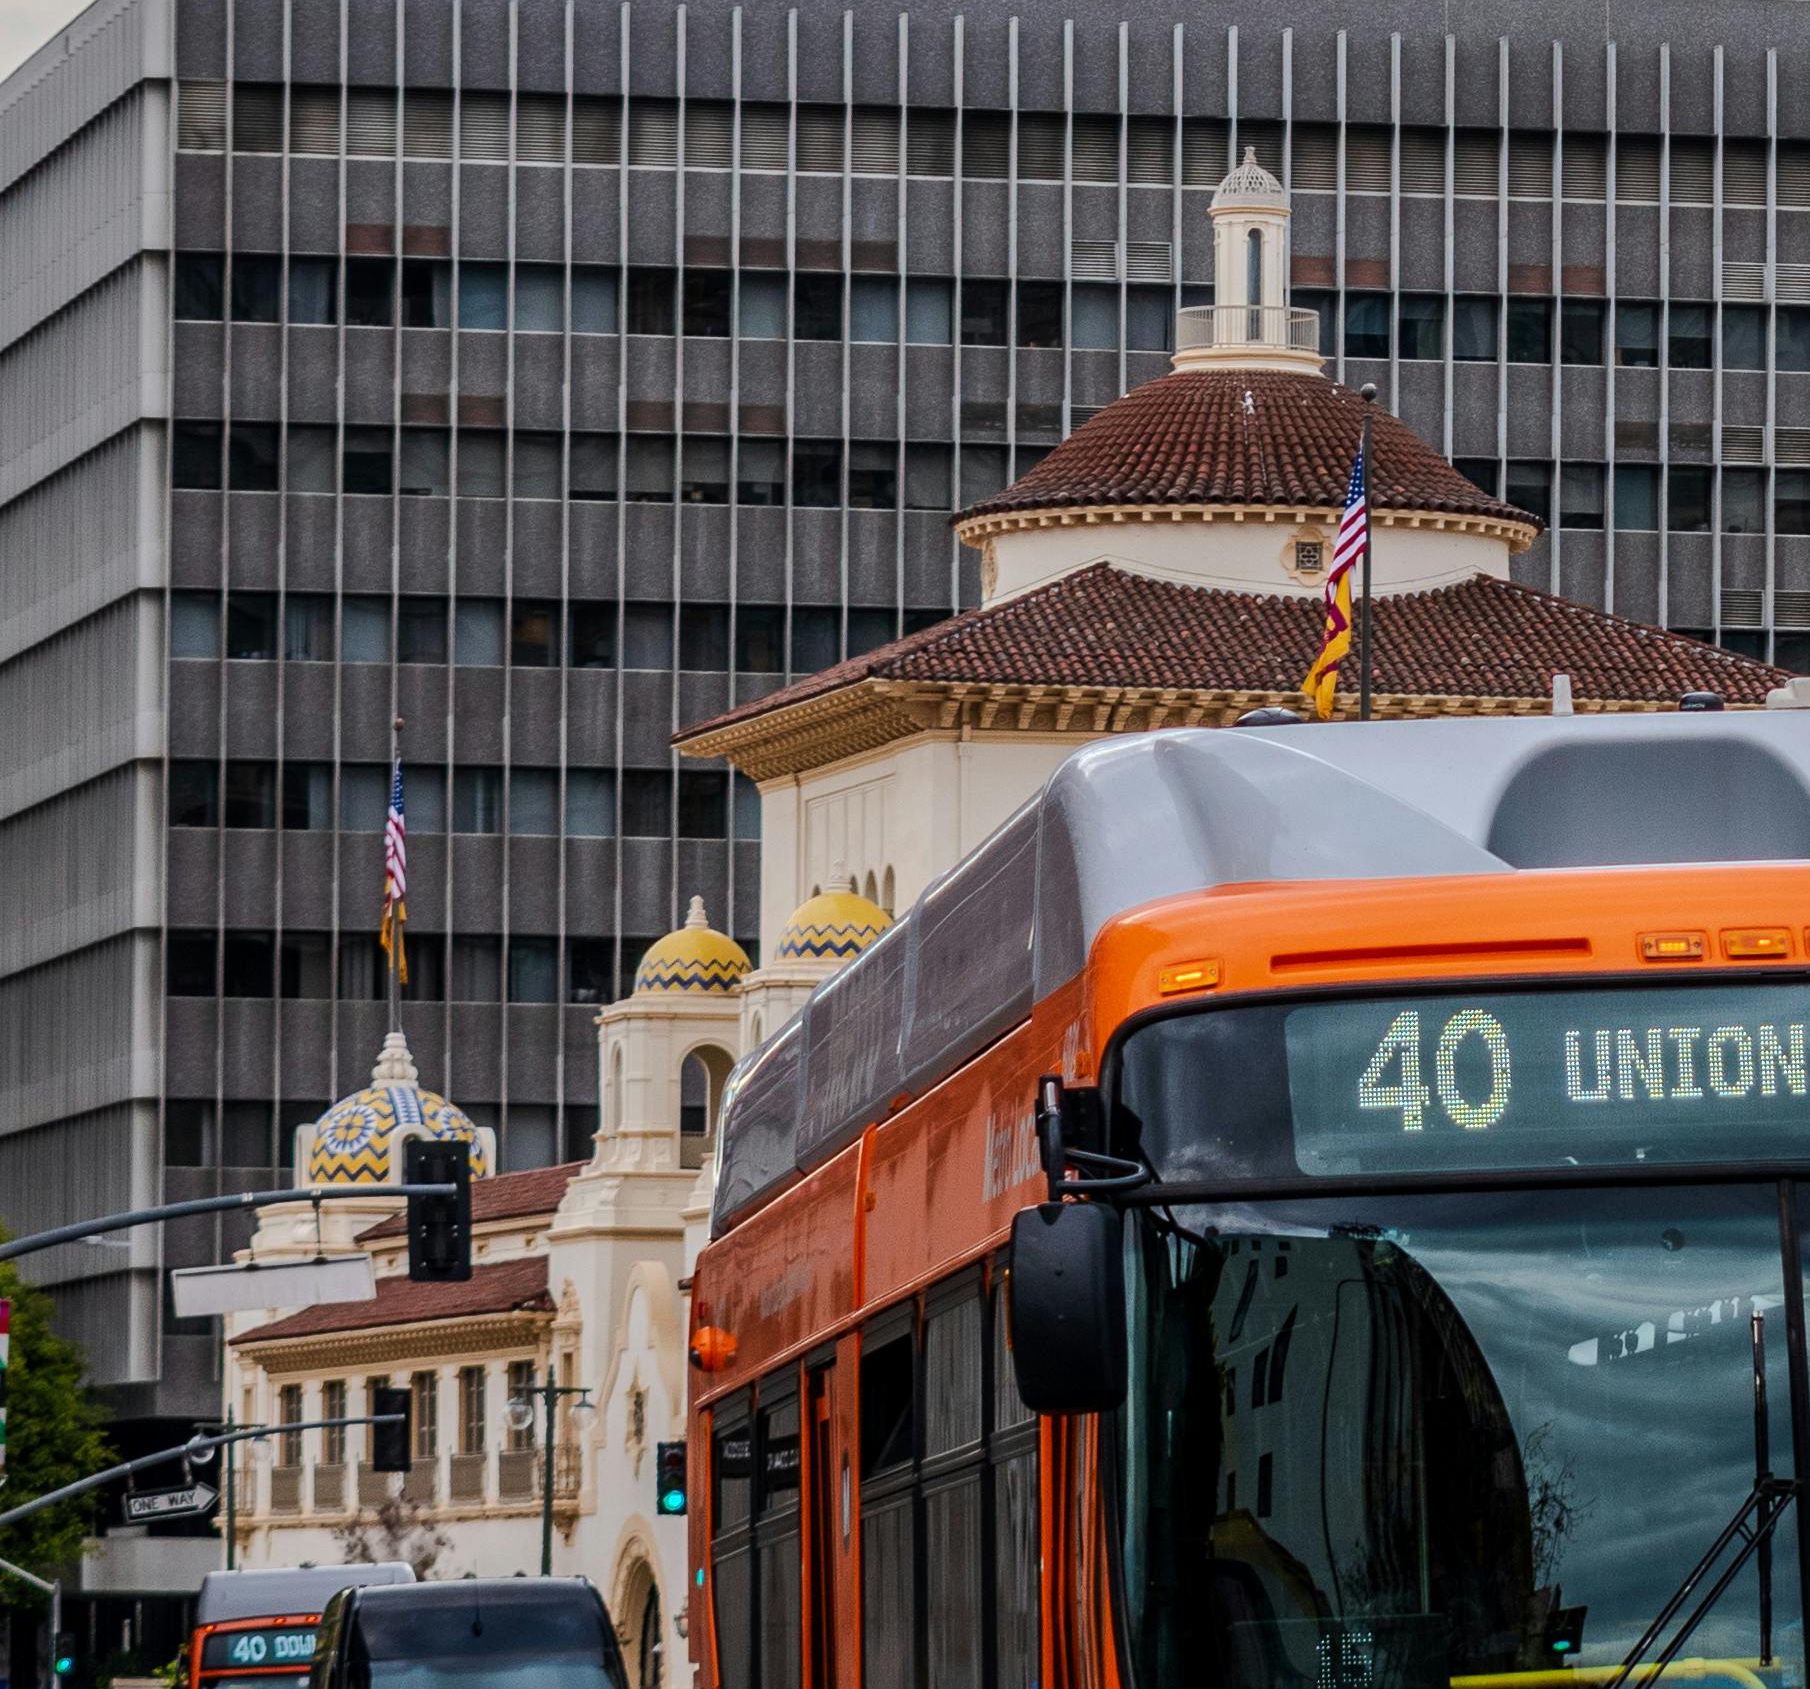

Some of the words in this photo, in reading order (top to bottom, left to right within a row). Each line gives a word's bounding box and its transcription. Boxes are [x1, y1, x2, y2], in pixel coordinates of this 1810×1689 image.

[1359, 1008, 1512, 1131] 40
[1566, 1023, 1806, 1101] UNION
[133, 1496, 159, 1512] ONE
[167, 1491, 196, 1506] WAY
[233, 1635, 267, 1662] 40
[1314, 1632, 1373, 1688] 15
